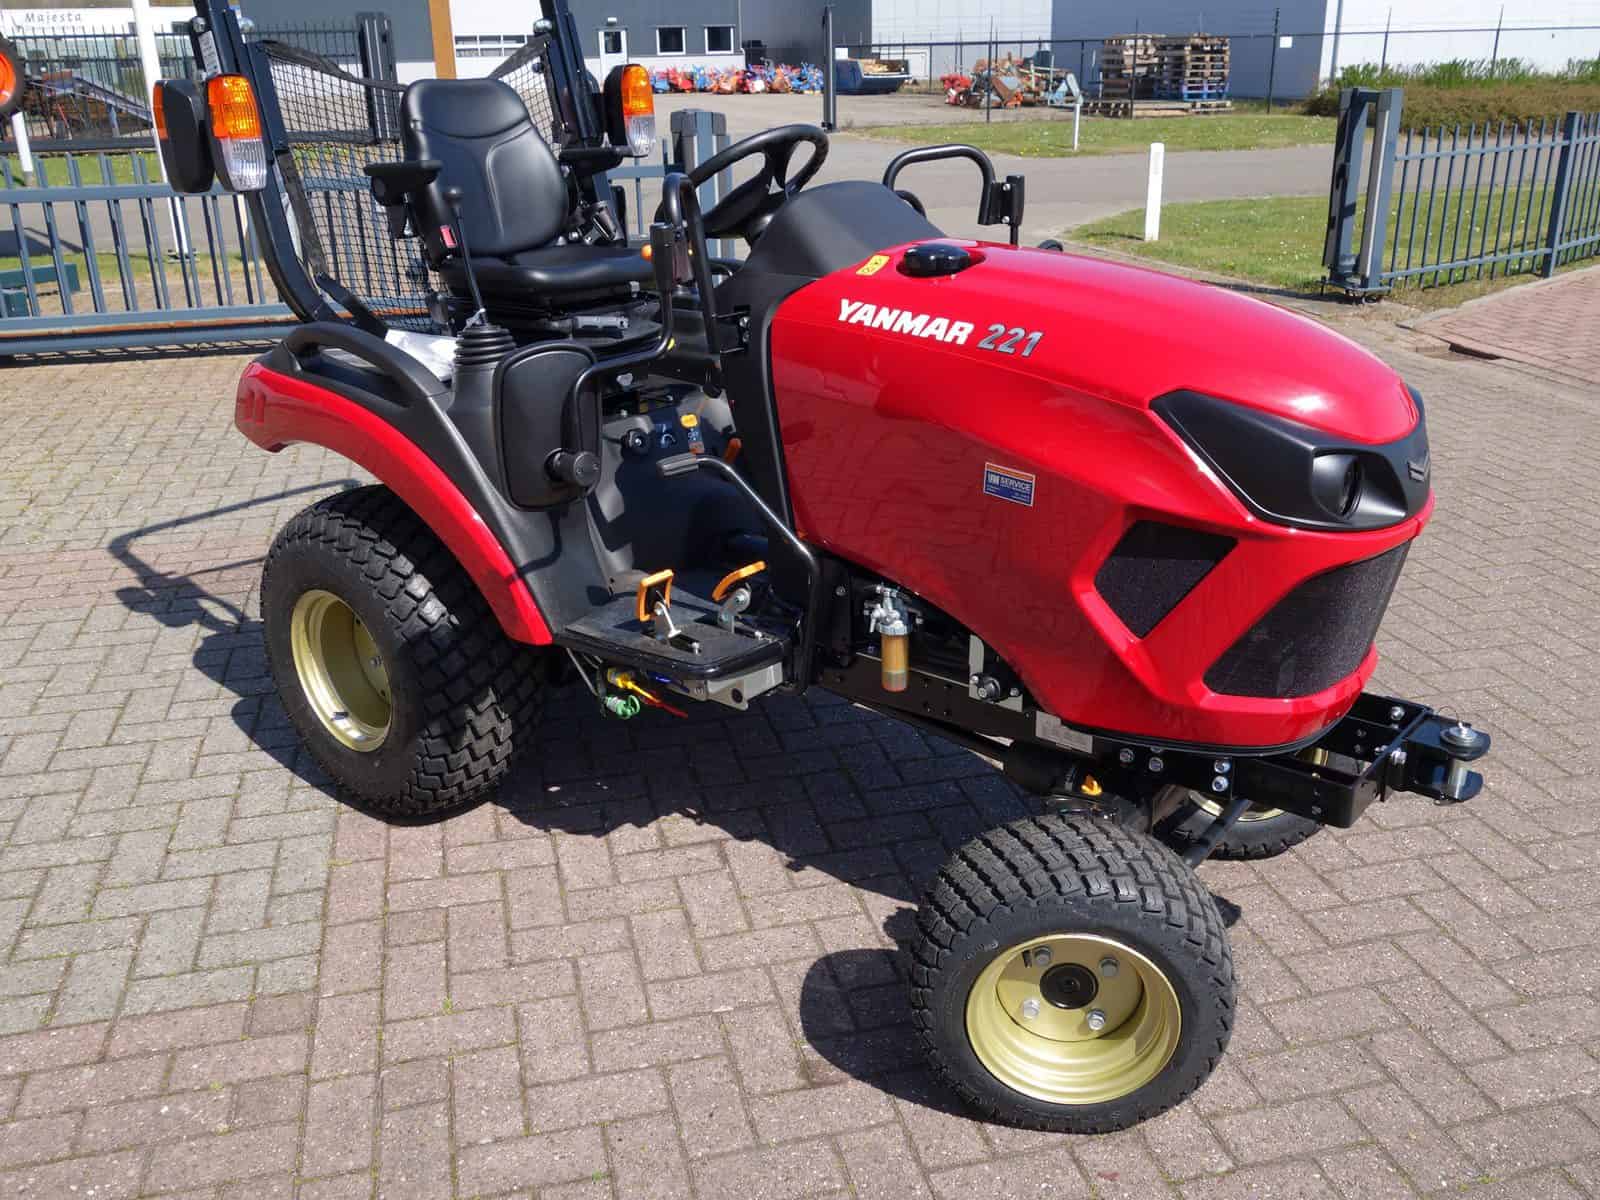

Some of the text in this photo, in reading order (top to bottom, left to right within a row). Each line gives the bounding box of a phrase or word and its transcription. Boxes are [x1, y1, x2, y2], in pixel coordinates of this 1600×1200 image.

[838, 299, 1043, 356] YANMAR 221
[1000, 476, 1032, 491] SERVICE
